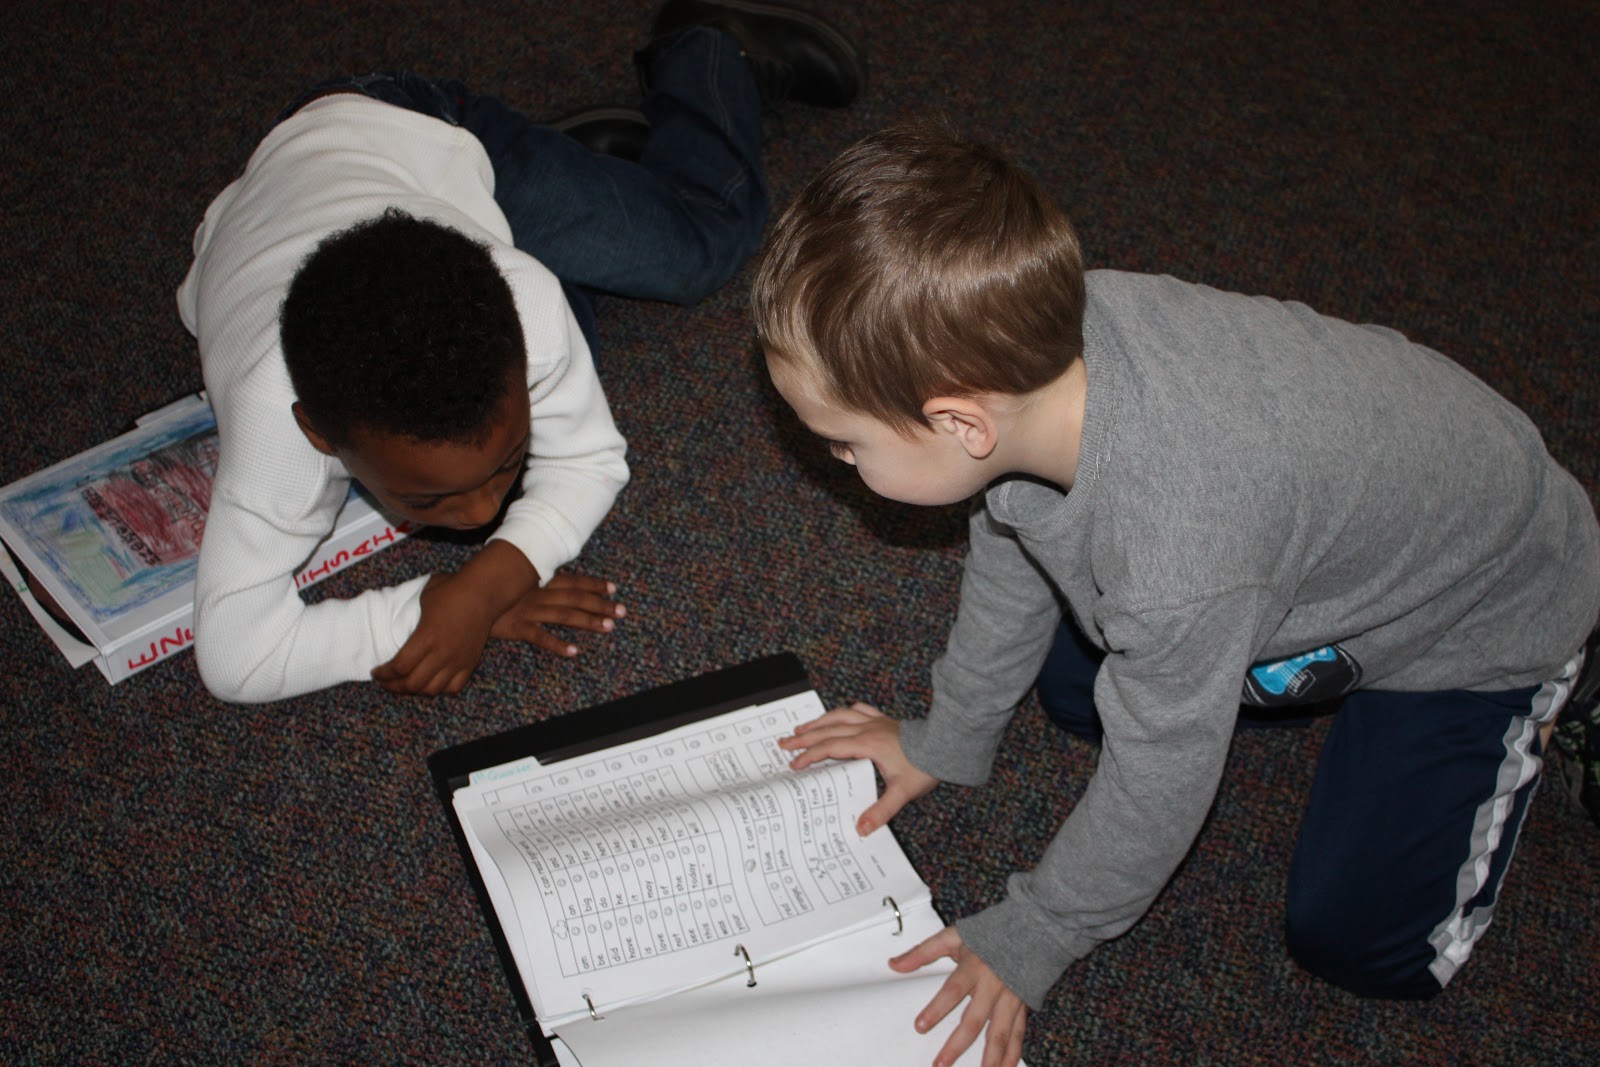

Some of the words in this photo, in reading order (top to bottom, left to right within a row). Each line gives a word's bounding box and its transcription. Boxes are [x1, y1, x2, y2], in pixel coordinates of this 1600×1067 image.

[737, 806, 749, 825] read
[745, 825, 754, 841] can
[803, 821, 811, 836] can
[765, 851, 774, 871] blue
[688, 862, 698, 889] today
[645, 880, 654, 899] may
[660, 885, 669, 896] of
[675, 875, 684, 892] she
[583, 897, 593, 912] big
[600, 897, 608, 909] do
[615, 893, 624, 906] he
[568, 904, 577, 916] an
[702, 922, 713, 940] this
[625, 936, 637, 959] have
[657, 932, 668, 951] love
[672, 933, 682, 948] not
[609, 947, 622, 962] did
[643, 946, 652, 956] is
[581, 956, 590, 970] am
[597, 953, 606, 967] be
